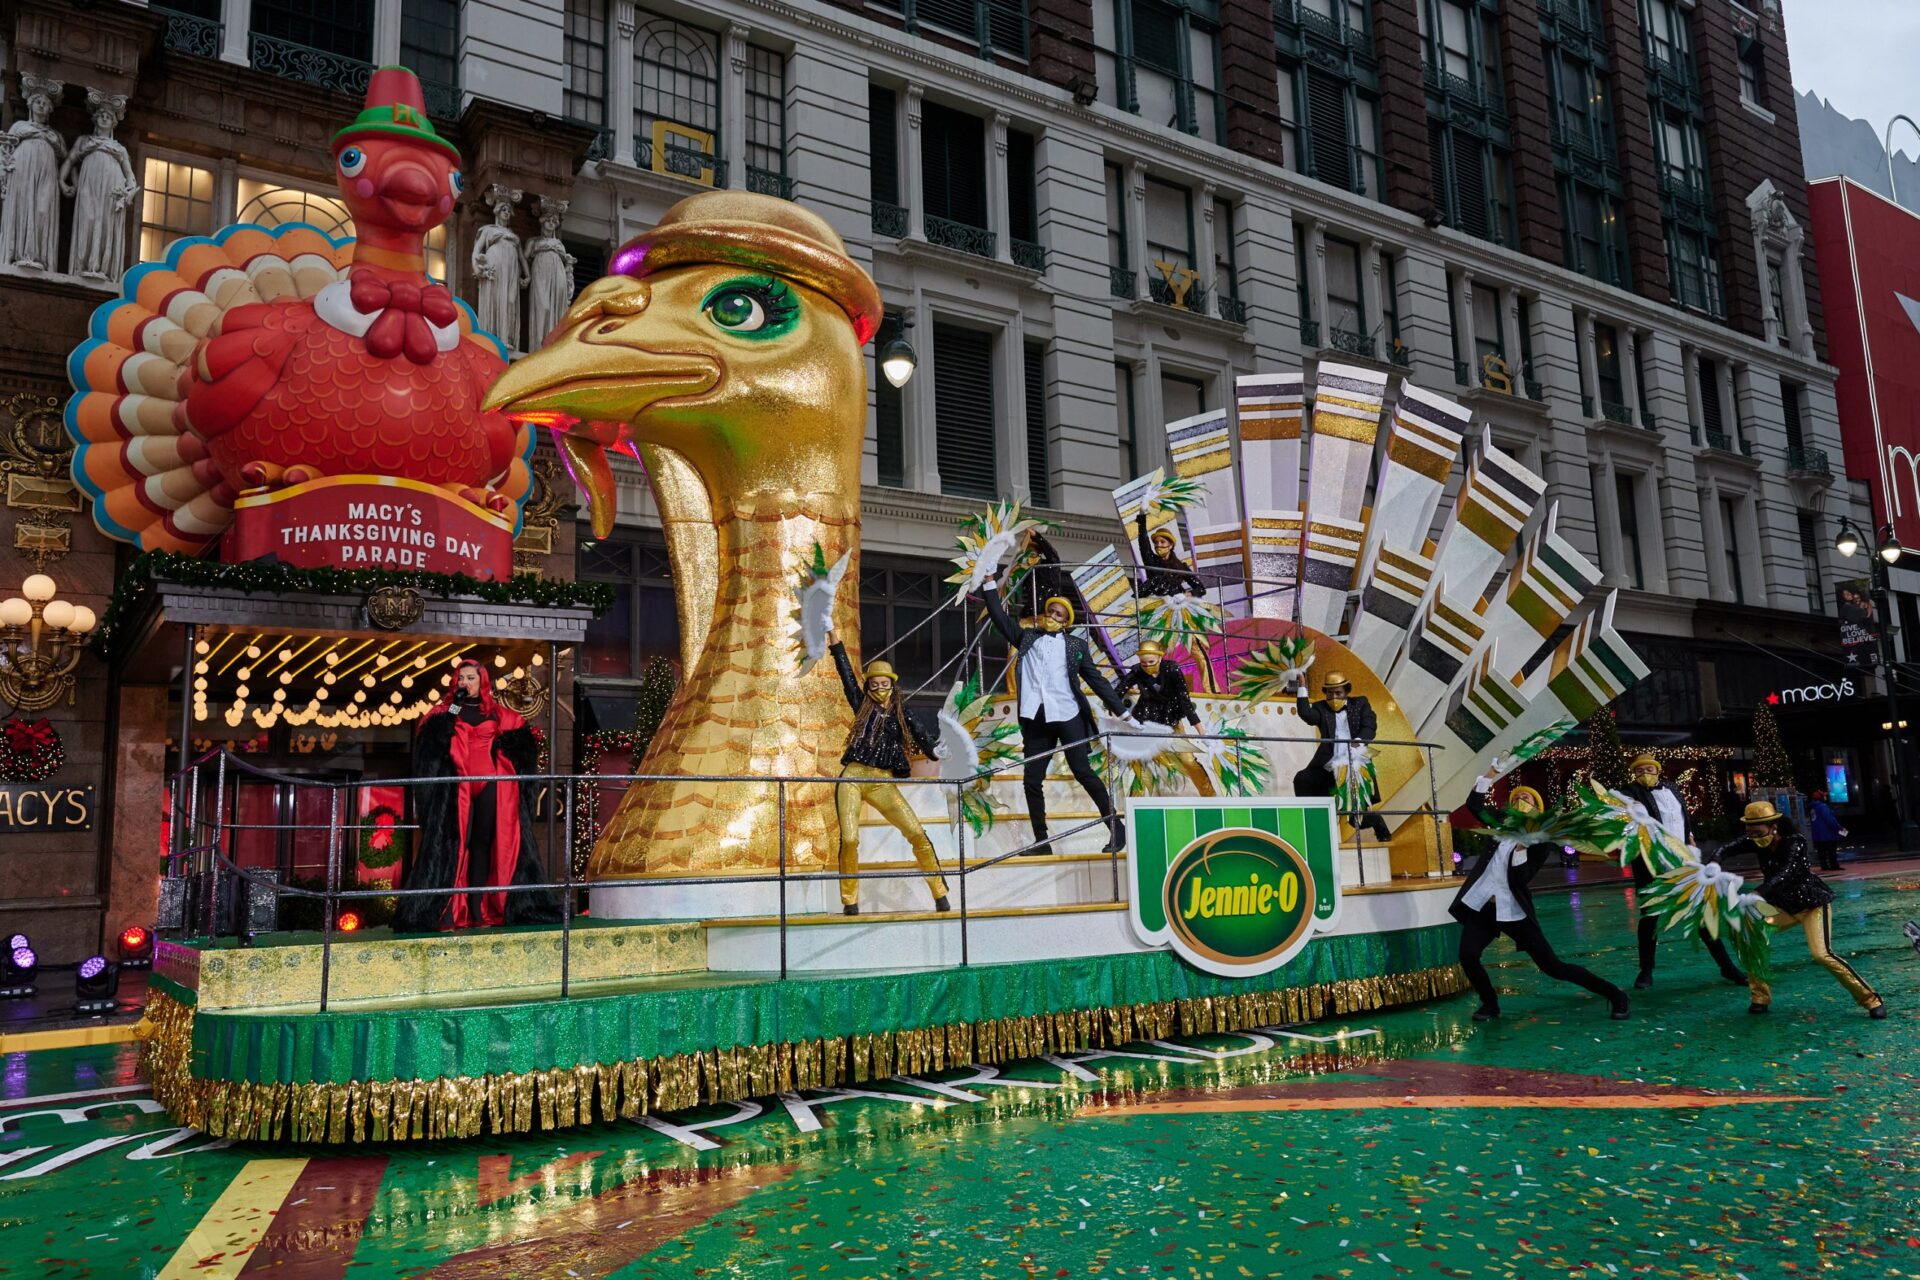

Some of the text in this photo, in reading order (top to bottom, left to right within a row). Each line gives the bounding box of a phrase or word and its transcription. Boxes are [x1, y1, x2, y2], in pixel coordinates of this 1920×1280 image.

[348, 503, 422, 526] MACY'S
[281, 523, 484, 561] THANKSGIVING DAY
[341, 545, 427, 569] PARADE
[1846, 628, 1870, 638] LOVE.
[1782, 677, 1854, 704] macy's
